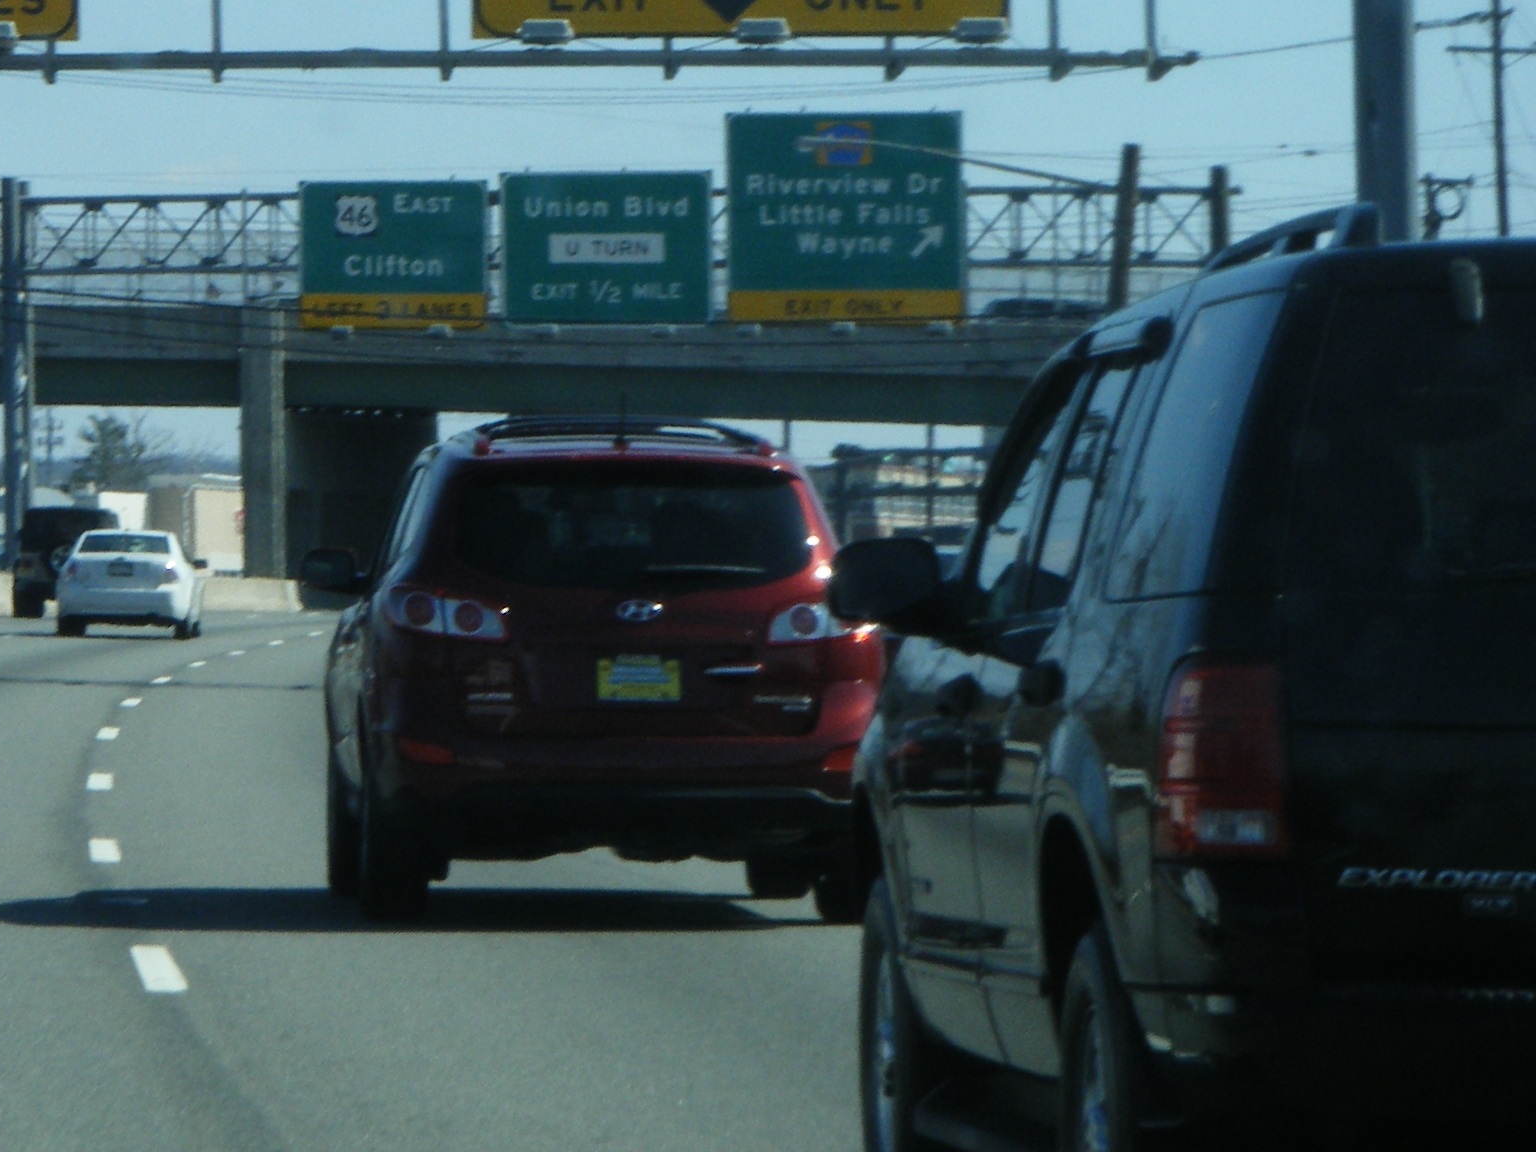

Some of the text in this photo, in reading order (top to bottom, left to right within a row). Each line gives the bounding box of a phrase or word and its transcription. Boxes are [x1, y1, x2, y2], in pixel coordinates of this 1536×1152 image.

[745, 173, 942, 194] Riverview Dr
[340, 194, 453, 228] 46 EAST
[523, 196, 690, 218] Union Blvd
[759, 202, 931, 225] Little Falls
[566, 239, 651, 258] U TURN
[795, 233, 894, 259] Wayne
[344, 255, 444, 277] Clifton
[530, 282, 580, 301] EXIT
[631, 282, 683, 300] MILE
